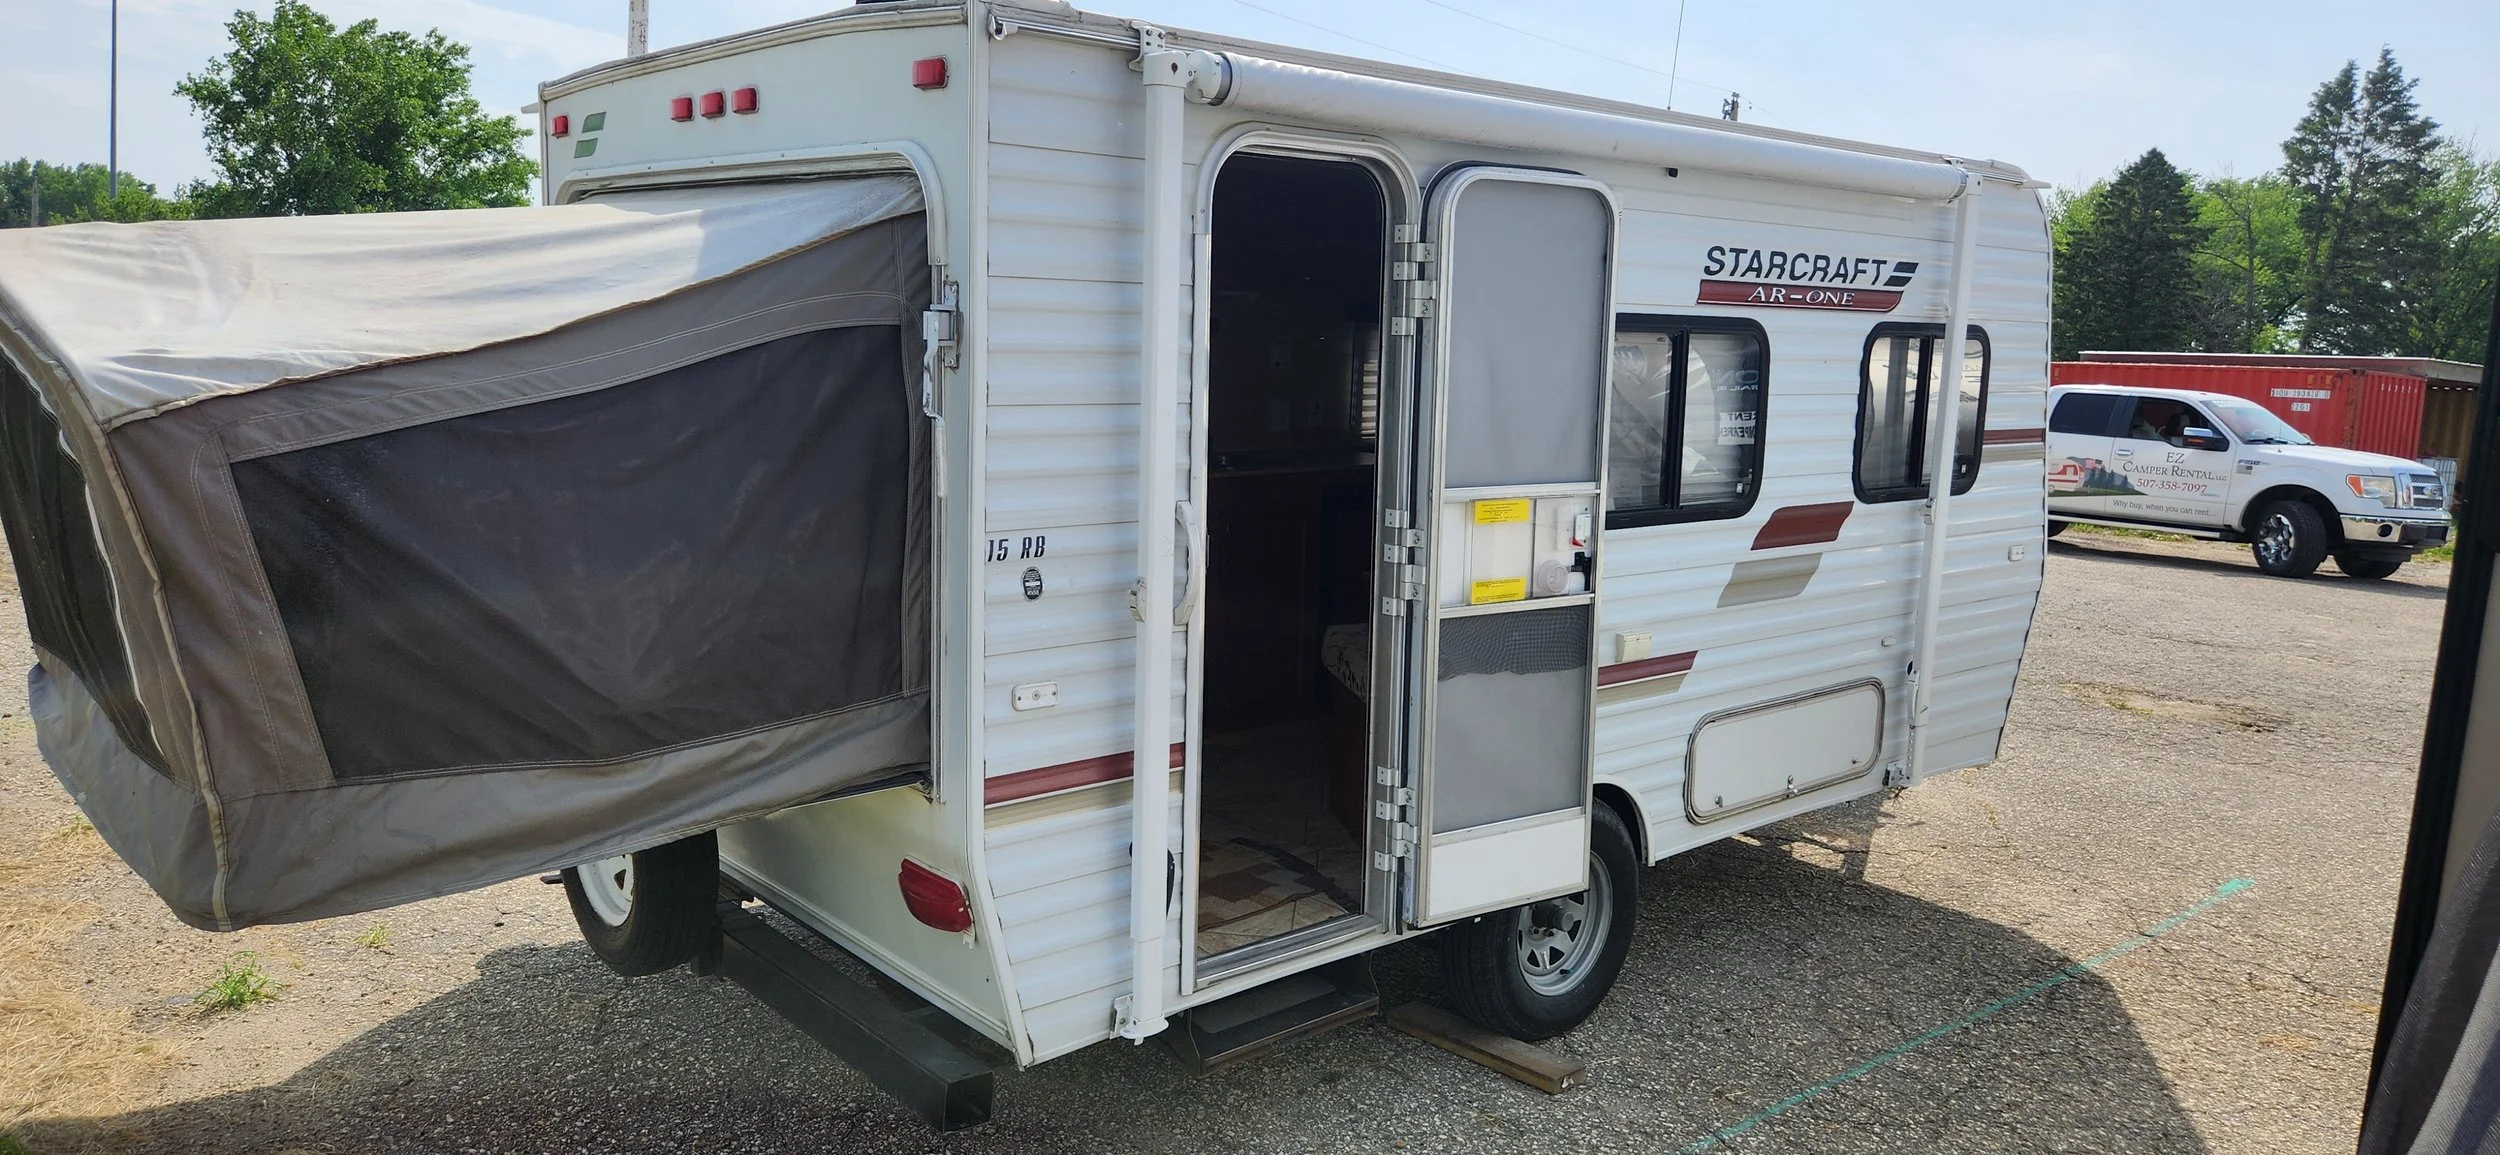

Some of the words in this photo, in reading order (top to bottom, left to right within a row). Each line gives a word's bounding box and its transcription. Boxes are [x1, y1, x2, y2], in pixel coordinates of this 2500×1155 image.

[1704, 245, 1888, 286] STARCRAFT
[1747, 286, 1856, 306] AR-ONE
[2166, 451, 2185, 464] EZ
[2122, 460, 2168, 476] CAMPER
[2171, 465, 2215, 480] RENTAL
[2136, 478, 2208, 493] 507-358-7097
[2113, 499, 2128, 509] Why
[2129, 501, 2144, 510] buy,
[2145, 503, 2164, 512] when
[2165, 506, 2179, 514] you
[2180, 507, 2193, 515] can
[987, 538, 1009, 563] 15
[1020, 535, 1046, 559] RB
